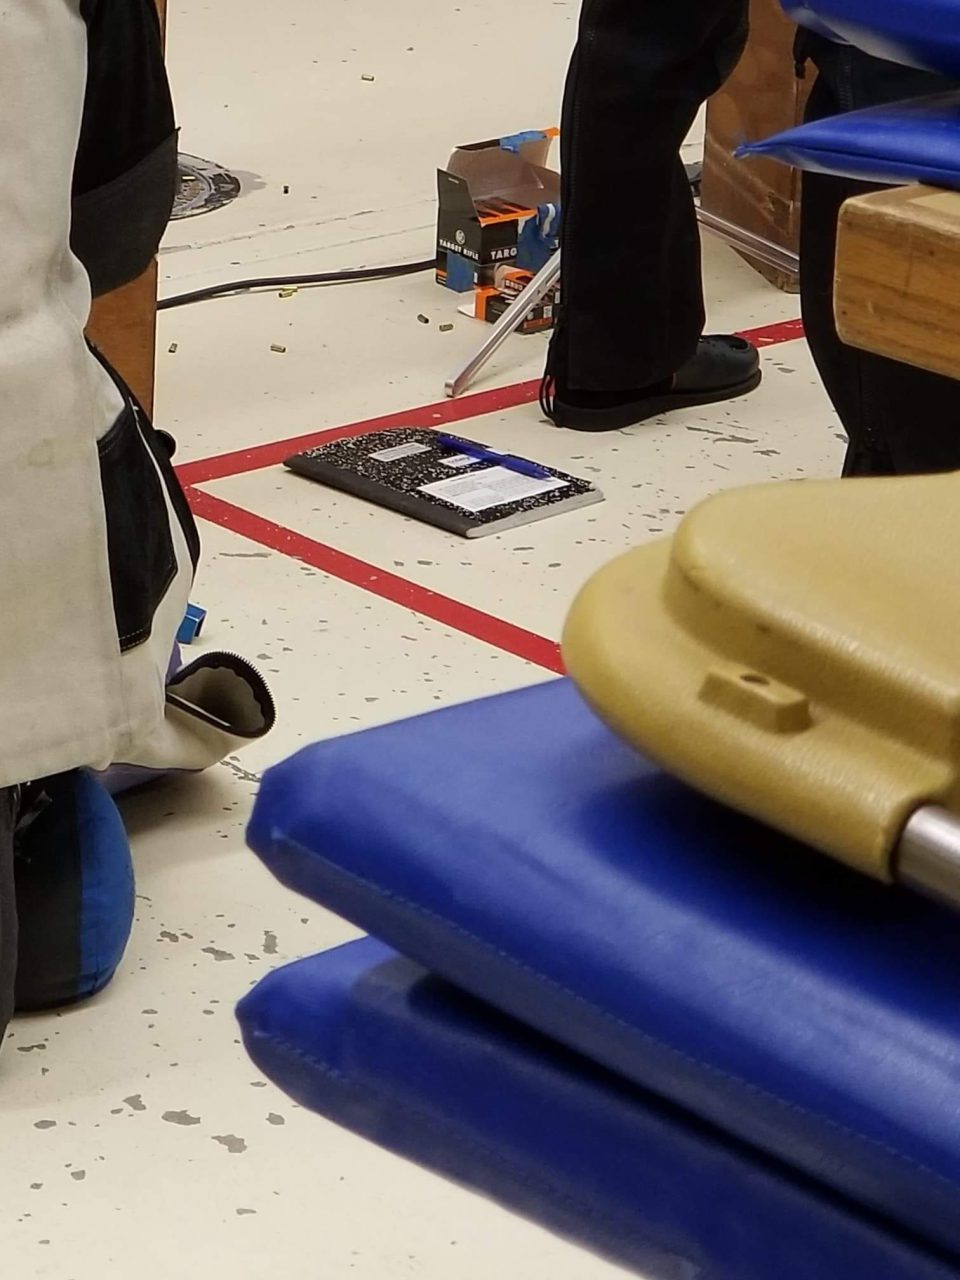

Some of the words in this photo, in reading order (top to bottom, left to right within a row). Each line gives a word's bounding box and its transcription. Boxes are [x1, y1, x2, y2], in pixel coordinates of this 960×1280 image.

[439, 238, 462, 254] TARGET
[463, 247, 479, 261] RIFLE
[490, 247, 517, 261] TARG
